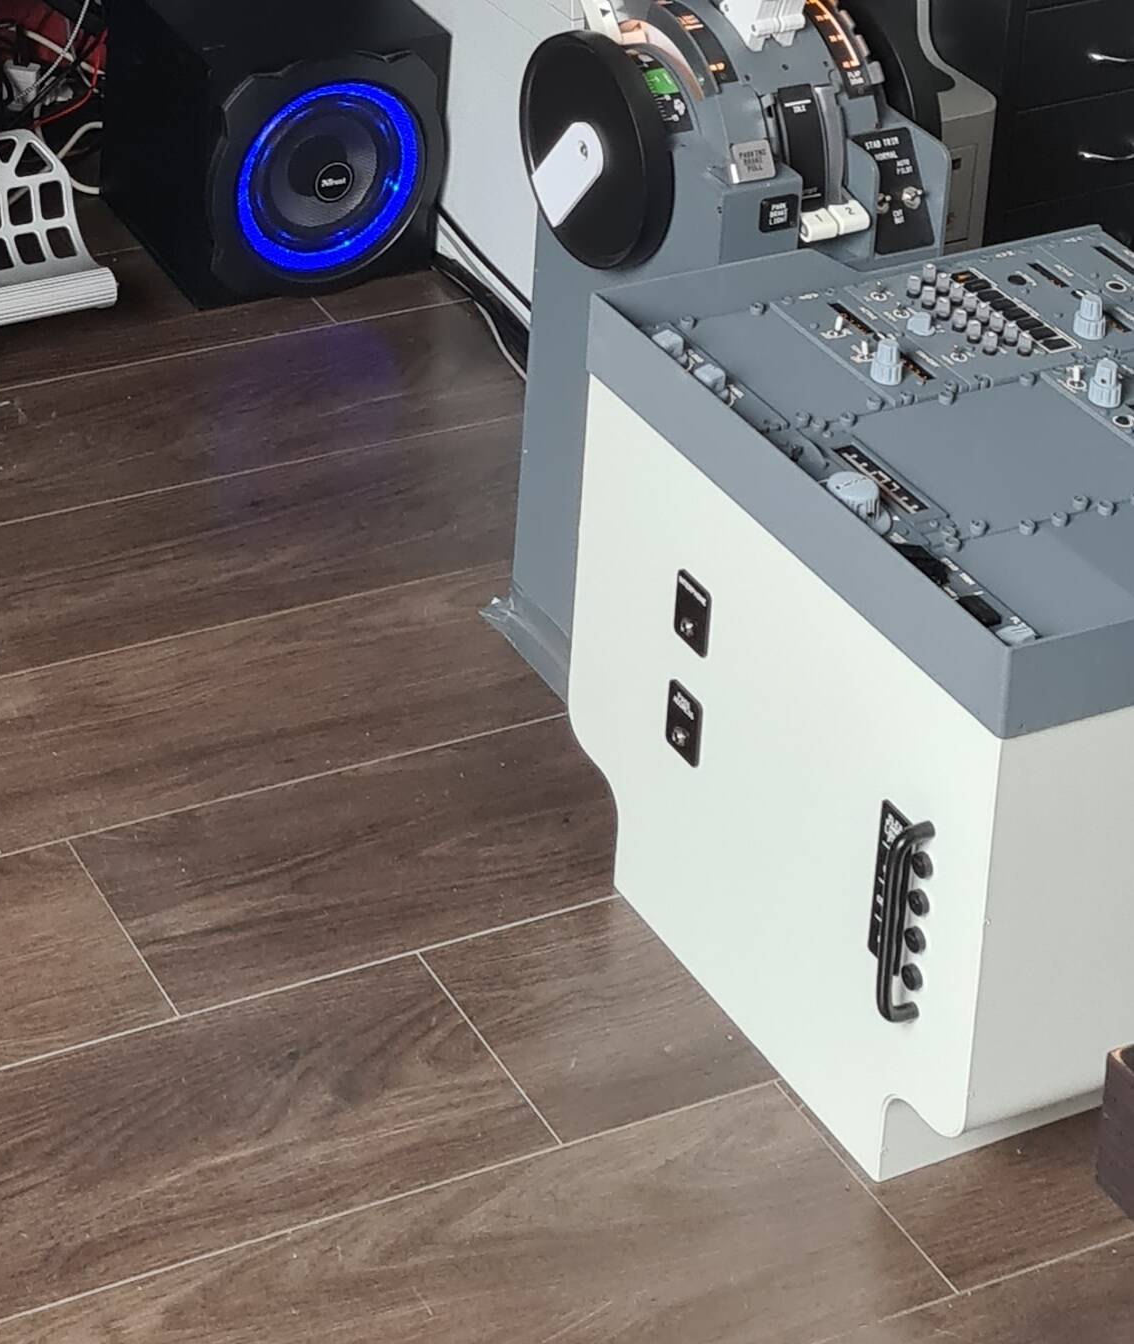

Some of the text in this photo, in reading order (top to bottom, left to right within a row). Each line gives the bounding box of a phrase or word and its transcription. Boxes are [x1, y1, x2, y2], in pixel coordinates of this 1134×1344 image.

[865, 136, 900, 150] STAB TRIM
[739, 148, 766, 158] PARKING
[874, 151, 899, 161] NORMAL
[747, 164, 763, 172] PULL
[325, 177, 346, 188] Trust
[771, 202, 787, 210] PARK
[845, 207, 854, 215] 2
